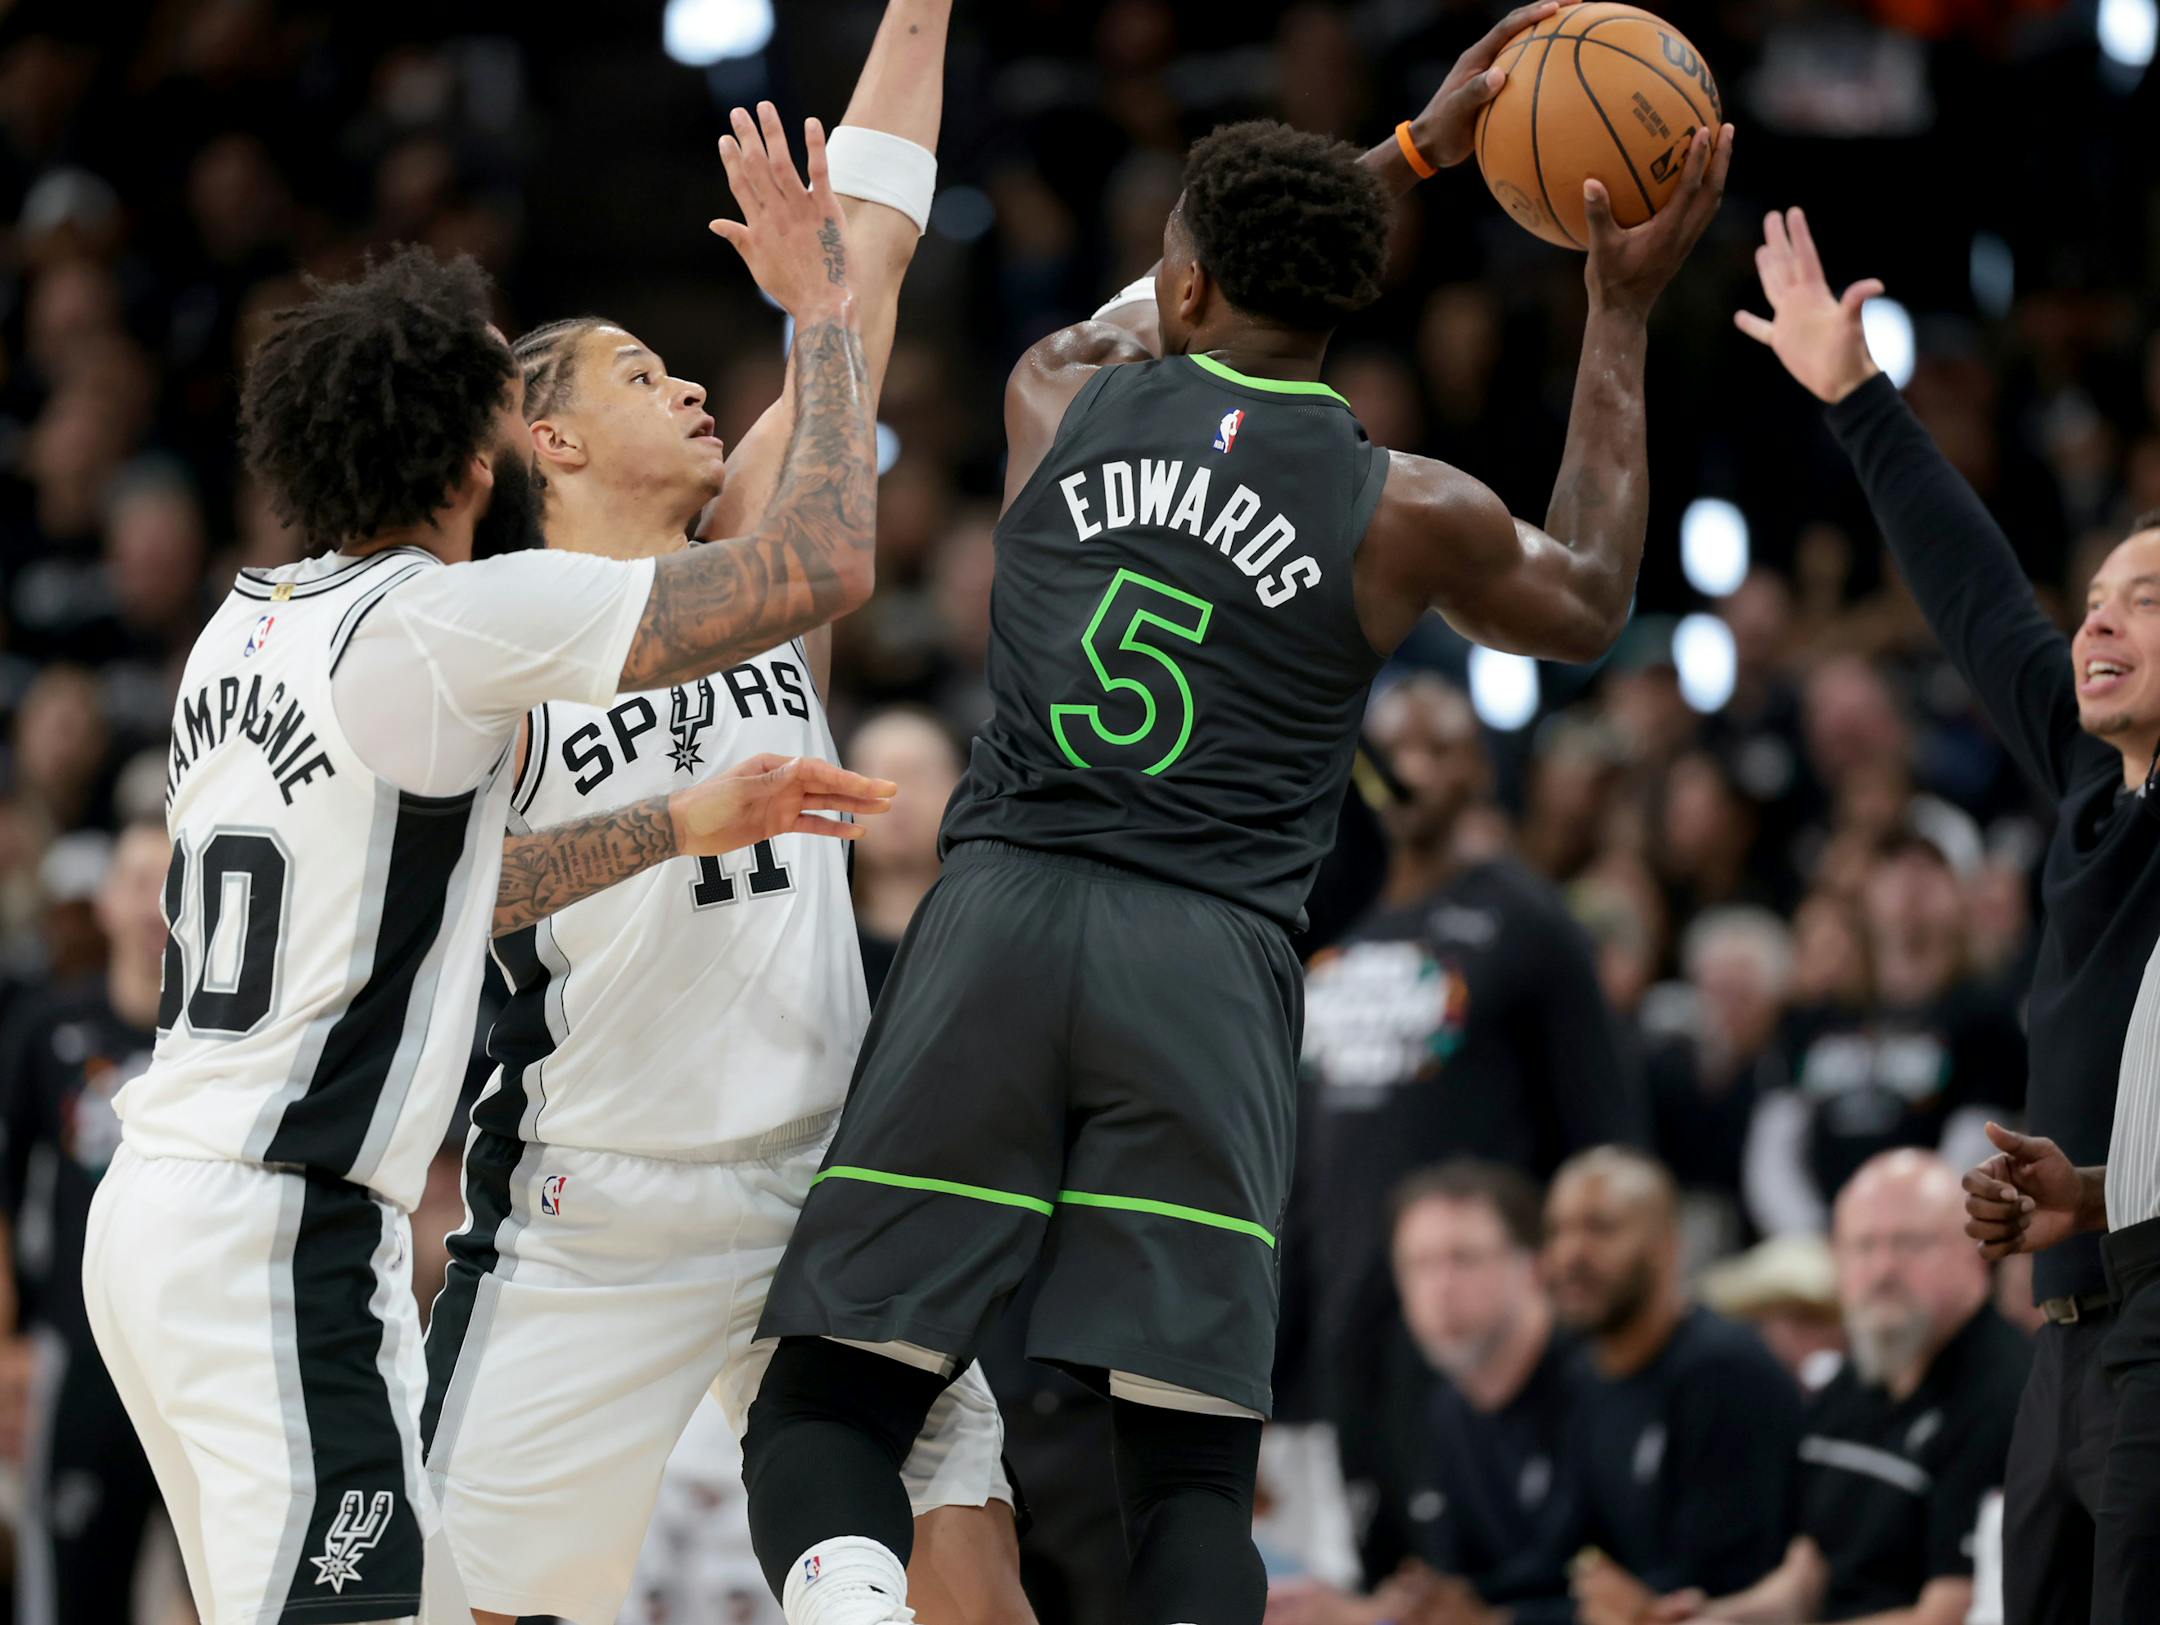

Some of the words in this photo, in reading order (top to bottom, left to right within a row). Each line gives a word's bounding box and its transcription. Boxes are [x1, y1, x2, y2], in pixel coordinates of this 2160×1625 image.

[1059, 458, 1322, 608] EDWARDS
[166, 674, 336, 815] AMPAGNIE
[562, 661, 810, 796] SPURS
[1050, 568, 1213, 776] 5
